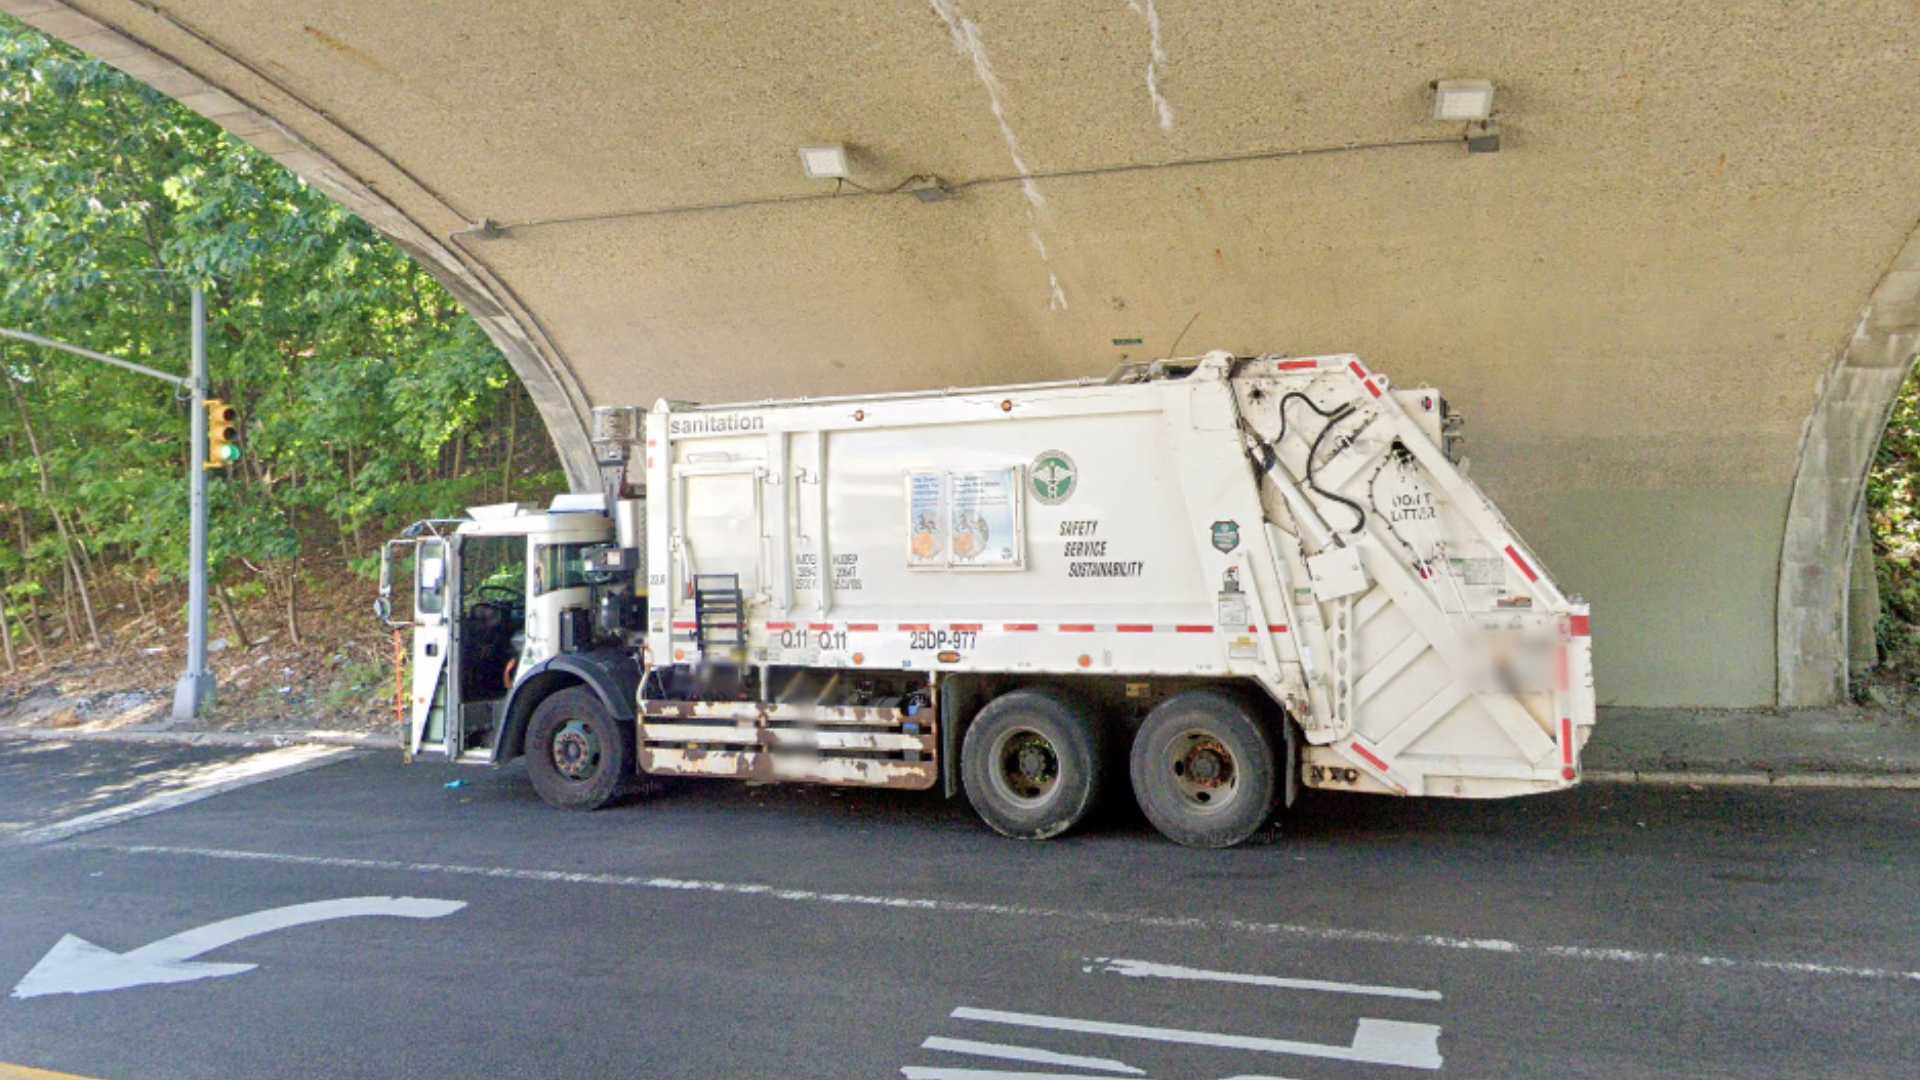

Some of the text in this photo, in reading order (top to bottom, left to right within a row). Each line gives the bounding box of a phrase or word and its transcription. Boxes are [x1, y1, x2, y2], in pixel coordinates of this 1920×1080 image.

[670, 413, 765, 434] sanitation
[1059, 520, 1099, 537] SAFETY
[1063, 541, 1107, 557] SERVICE
[1068, 561, 1144, 578] SUSTAINABILITY
[780, 629, 807, 649] Q.11
[818, 630, 847, 650] Q.11
[909, 631, 977, 650] 25DP-977
[1311, 765, 1360, 786] NYC
